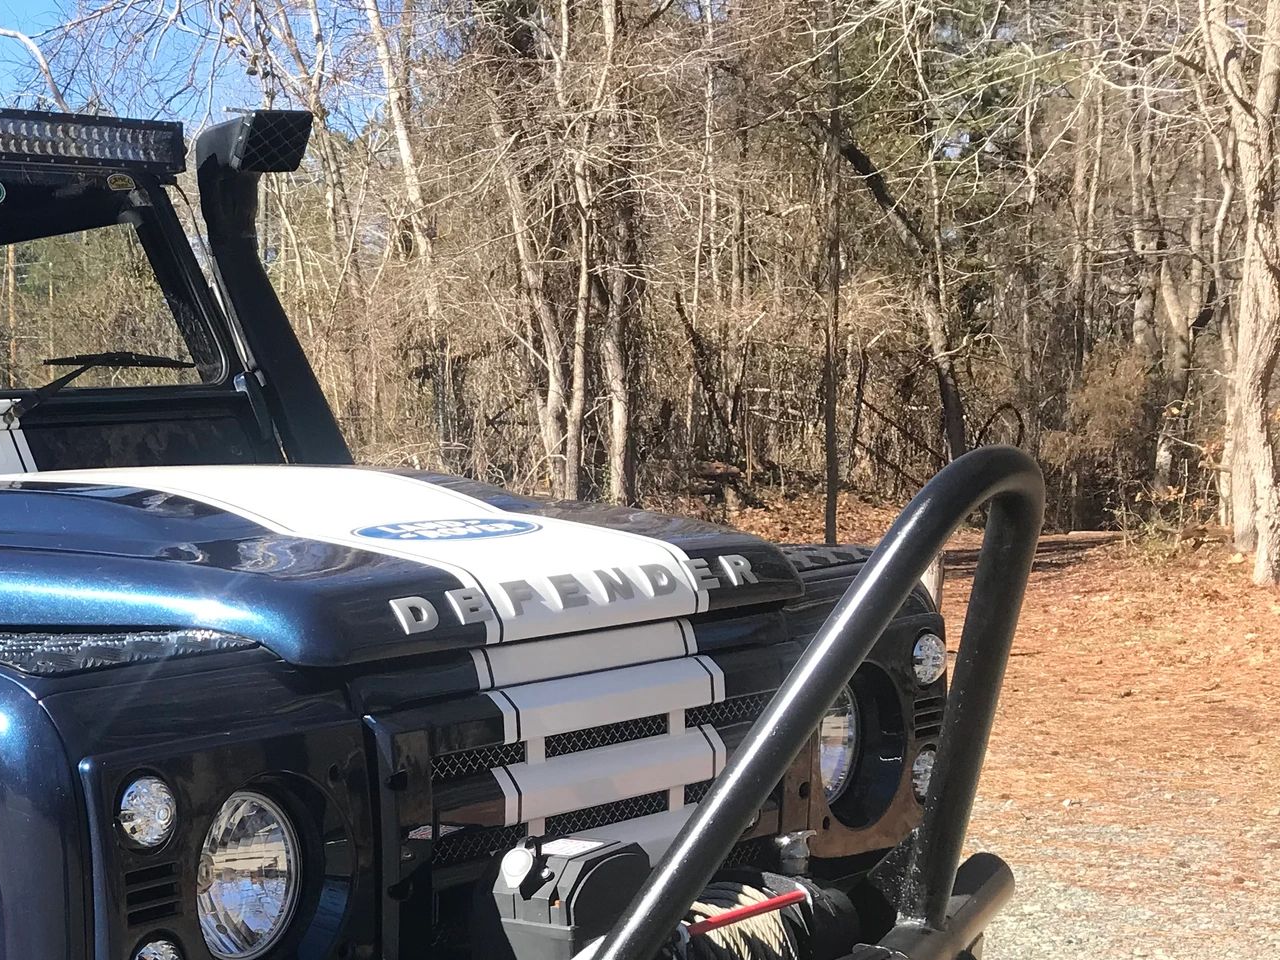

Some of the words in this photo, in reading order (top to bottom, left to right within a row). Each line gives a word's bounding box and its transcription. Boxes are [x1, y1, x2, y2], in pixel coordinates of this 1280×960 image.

[376, 520, 464, 534] LAND
[415, 522, 526, 539] ROVER
[389, 554, 759, 635] DEFENDER
